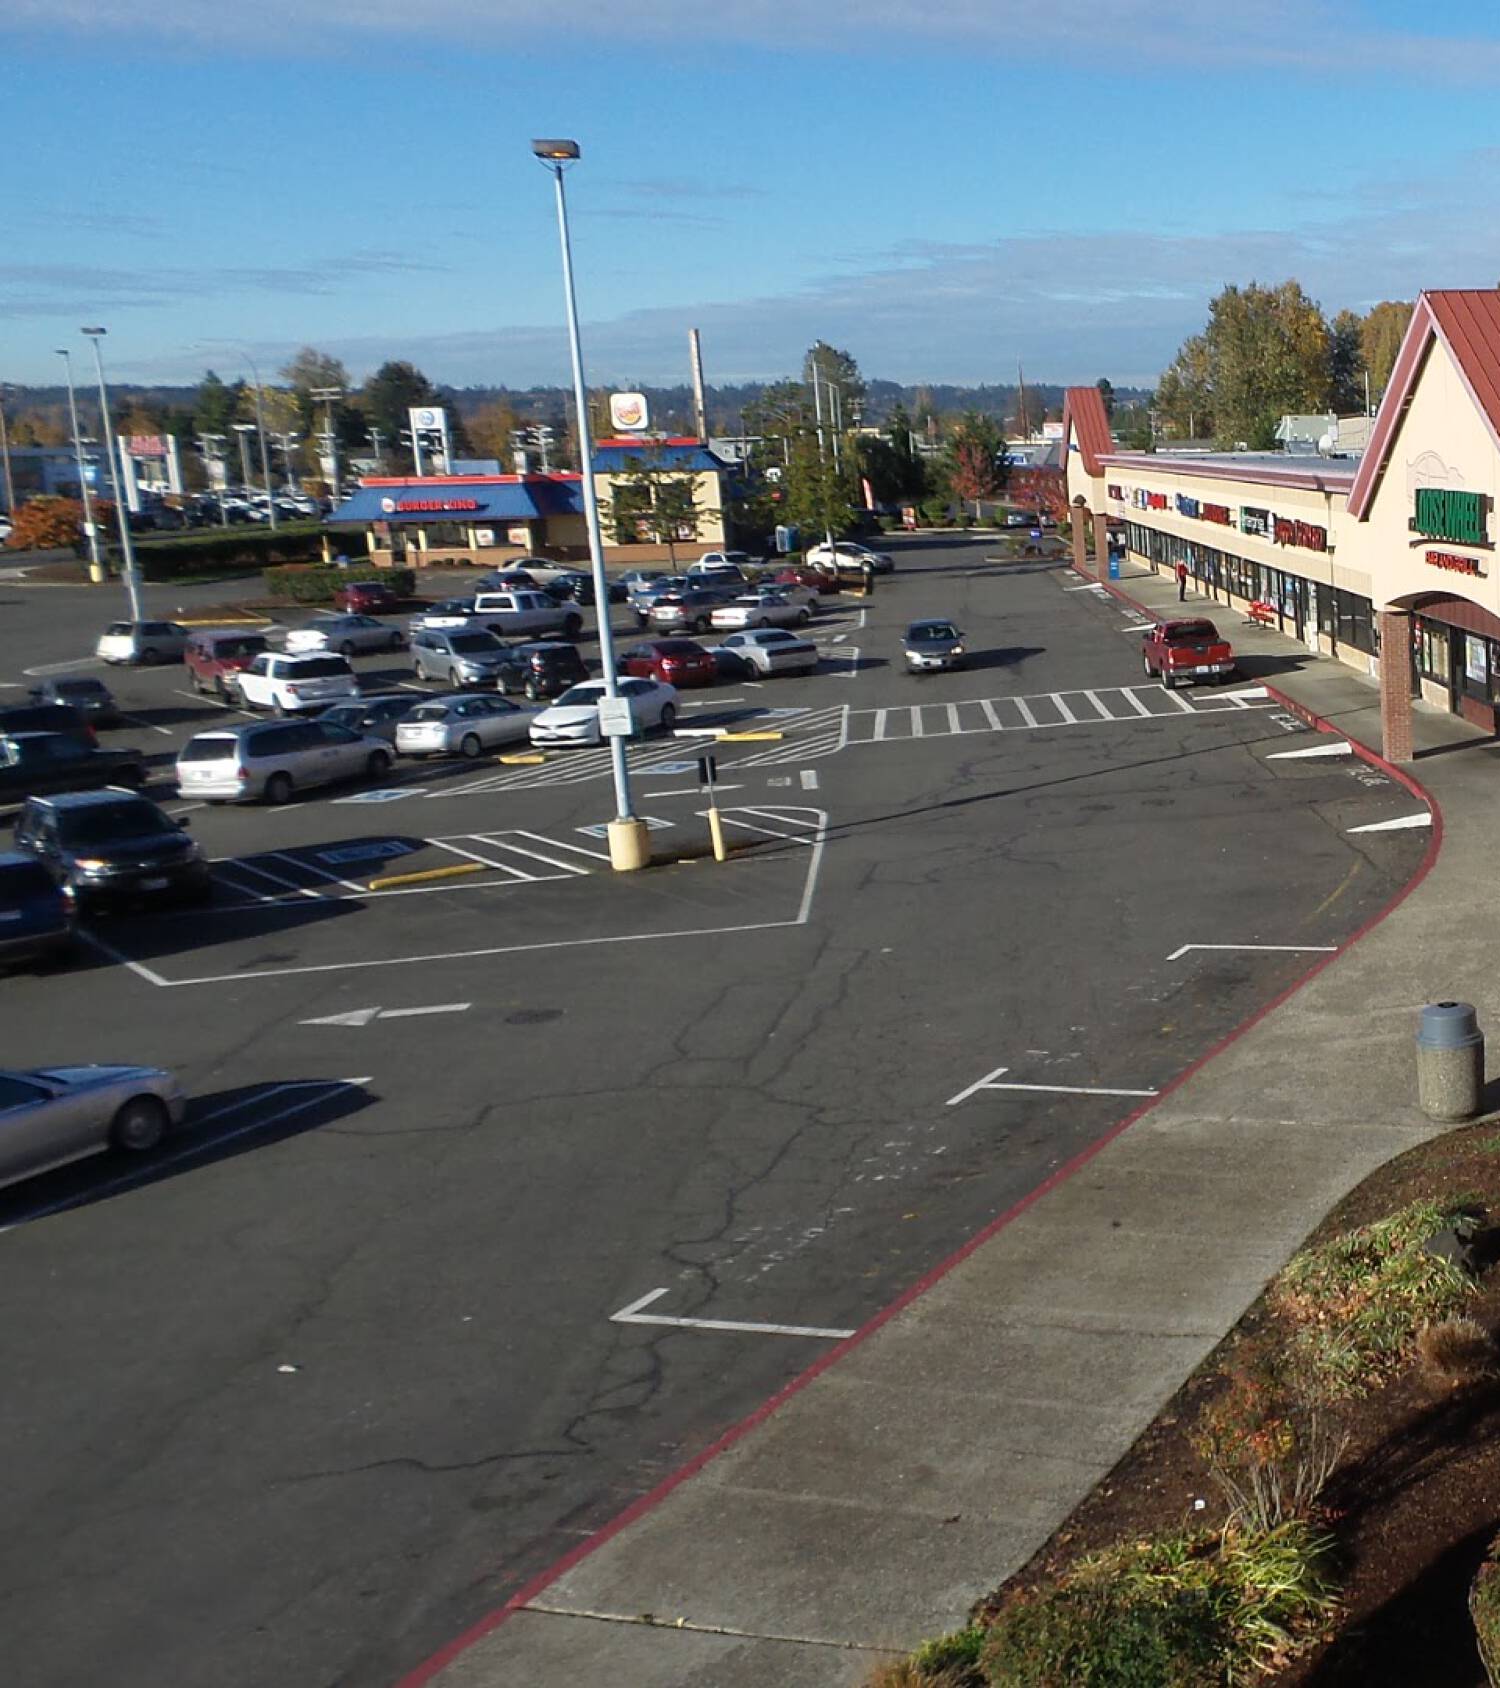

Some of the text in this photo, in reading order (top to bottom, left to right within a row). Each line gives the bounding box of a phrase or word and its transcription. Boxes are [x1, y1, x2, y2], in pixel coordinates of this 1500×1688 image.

[396, 497, 477, 512] BURGER KING
[1445, 491, 1482, 545] WHEEL
